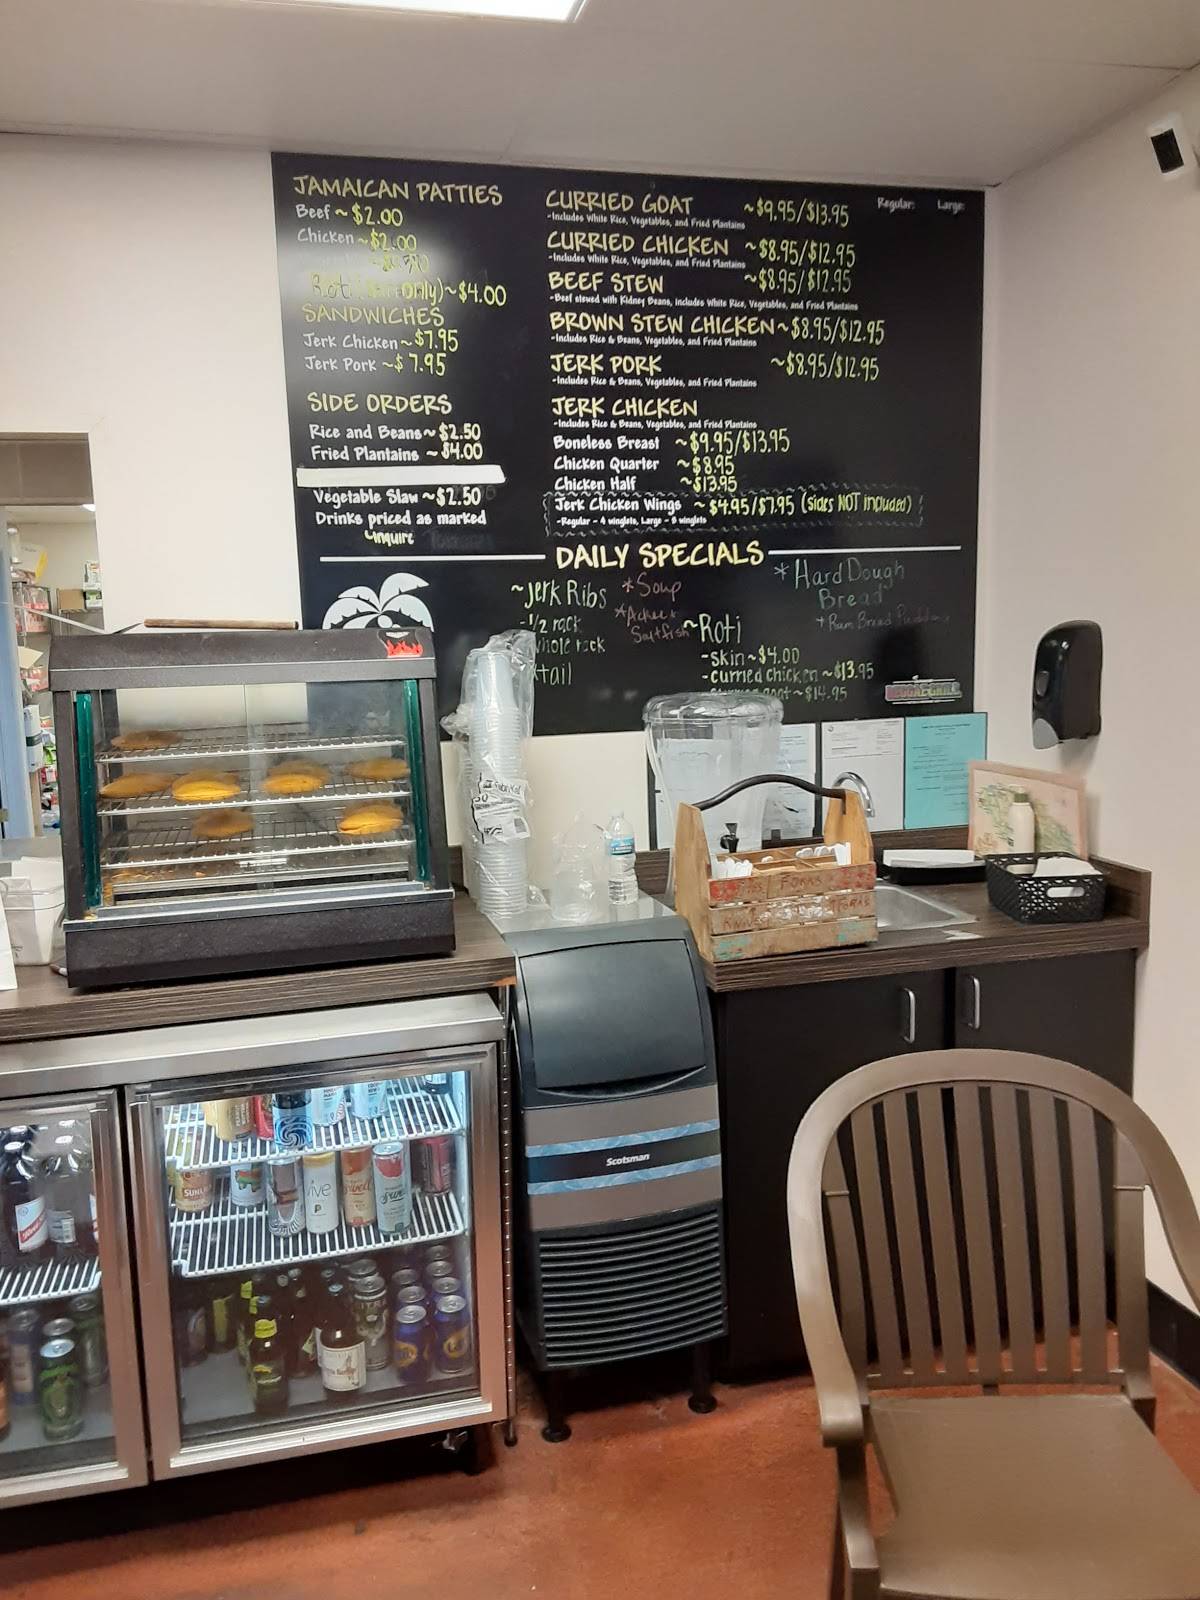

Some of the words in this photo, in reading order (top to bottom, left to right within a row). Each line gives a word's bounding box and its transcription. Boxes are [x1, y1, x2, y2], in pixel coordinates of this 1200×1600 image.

[293, 175, 410, 200] JAMAICAN
[416, 182, 503, 206] PATTIES
[546, 190, 634, 212] CURRIED
[642, 193, 693, 215] GOAT
[296, 204, 331, 220] Beef
[586, 214, 608, 224] White
[610, 215, 628, 225] Rice,
[631, 216, 672, 228] Vegetables,
[675, 218, 689, 227] and
[691, 218, 710, 229] Fried
[712, 220, 746, 230] Plantains
[297, 228, 354, 245] Chicken
[547, 231, 635, 252] CURRIED
[643, 235, 729, 257] CHICKEN
[588, 254, 609, 264] White
[611, 255, 629, 266] Rice,
[632, 256, 673, 269] Vegetables,
[675, 257, 689, 267] and
[692, 257, 710, 268] Fried
[713, 259, 746, 269] Plantains
[548, 271, 604, 292] BEEF
[610, 272, 664, 294] STEW
[575, 294, 600, 304] stewed
[603, 295, 618, 305] with
[619, 295, 645, 308] Kidney
[648, 297, 673, 308] Beans,
[675, 297, 704, 308] includes
[707, 298, 727, 308] White
[729, 299, 747, 310] Rice,
[749, 300, 789, 312] Vegetables,
[790, 301, 804, 310] and
[806, 301, 825, 311] Fried
[827, 301, 858, 311] Plantains
[302, 304, 444, 326] SANDWICHES
[549, 311, 624, 332] BROWN
[630, 313, 683, 334] STEW
[691, 315, 775, 337] CHICKEN
[303, 333, 337, 348] Jerk
[343, 334, 398, 350] Chicken
[590, 335, 606, 344] Rice
[617, 335, 643, 346] Beans,
[644, 336, 685, 348] Vegetables,
[687, 338, 701, 347] and
[703, 337, 723, 348] Fried
[724, 338, 757, 348] Plantains
[304, 356, 337, 371] Jerk
[343, 357, 377, 372] Pork
[550, 353, 604, 375] JERK
[610, 354, 662, 376] PORK
[590, 376, 607, 386] Rice
[617, 377, 643, 388] Beans,
[645, 377, 686, 389] Vegetables,
[688, 377, 701, 387] and
[703, 377, 723, 388] Fried
[724, 378, 757, 388] Plantains
[307, 391, 358, 412] SIDE
[366, 393, 452, 415] ORDERS
[551, 397, 605, 418] JERK
[612, 397, 698, 418] CHICKEN
[309, 423, 341, 440] Rice
[346, 424, 373, 440] and
[378, 425, 422, 440] Beans
[592, 419, 608, 429] Rice
[619, 420, 644, 431] Beans,
[646, 419, 687, 432] Vegetables,
[689, 419, 701, 429] and
[704, 419, 723, 429] Fried
[724, 420, 757, 429] Plantains
[553, 435, 612, 450] Boneless
[617, 435, 660, 450] Breast
[311, 446, 349, 461] Fried
[353, 447, 419, 462] Plantains
[554, 455, 605, 471] Chicken
[610, 457, 660, 474] Quarter
[554, 476, 605, 491] Chicken
[610, 475, 637, 491] Half
[312, 489, 382, 509] Vegetable
[386, 489, 419, 504] Slaw
[554, 498, 586, 512] Jerk
[589, 497, 639, 512] Chicken
[644, 498, 682, 515] Wings
[838, 492, 860, 511] NOT
[315, 512, 363, 525] Drinks
[367, 510, 411, 528] priced
[416, 513, 432, 525] as
[437, 510, 487, 525] marked
[641, 517, 662, 527] Large
[679, 516, 707, 527] winglets
[556, 543, 629, 570] DAILY
[639, 540, 765, 567] SPECIALS
[795, 558, 843, 590] Hard
[847, 557, 904, 590] Dough
[567, 580, 607, 608] Ribs
[819, 584, 883, 610] Bread
[553, 615, 581, 633] rack
[576, 636, 605, 653] rack
[766, 666, 818, 684] chicken
[606, 1154, 650, 1167] Scotsman
